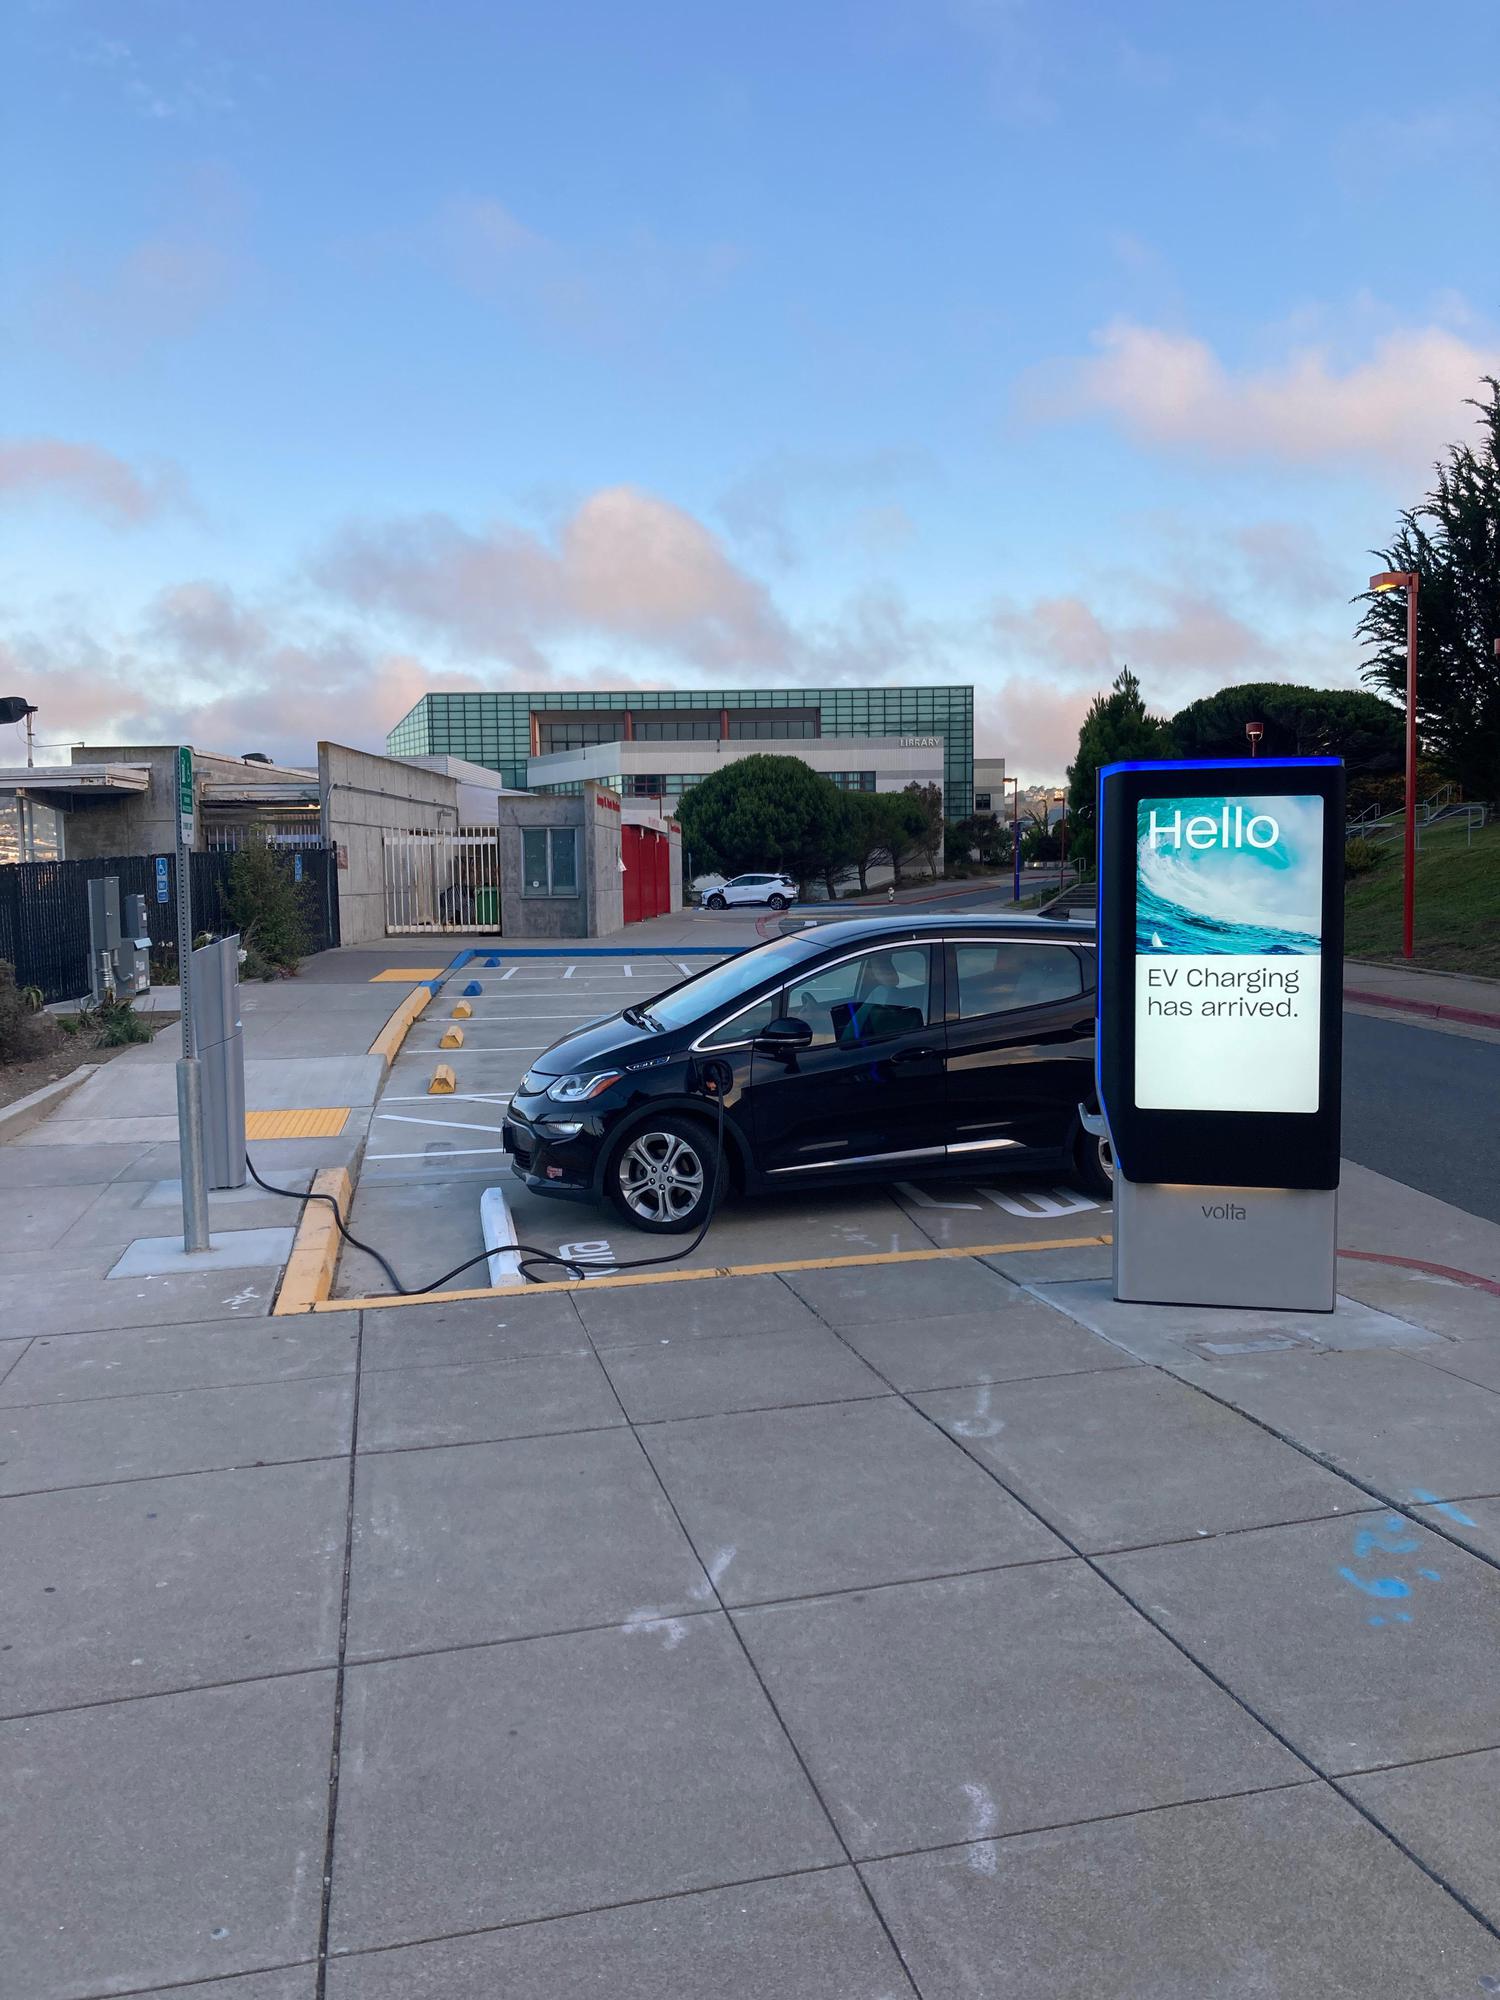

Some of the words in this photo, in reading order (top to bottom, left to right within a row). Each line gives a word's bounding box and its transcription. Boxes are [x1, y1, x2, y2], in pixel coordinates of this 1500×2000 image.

[900, 738, 940, 747] LIBRARY
[1149, 806, 1280, 849] Hello
[1148, 968, 1178, 987] EV
[1186, 967, 1300, 994] Charging
[1148, 996, 1193, 1016] has
[1201, 997, 1298, 1018] arrived.
[1201, 1203, 1247, 1220] volta
